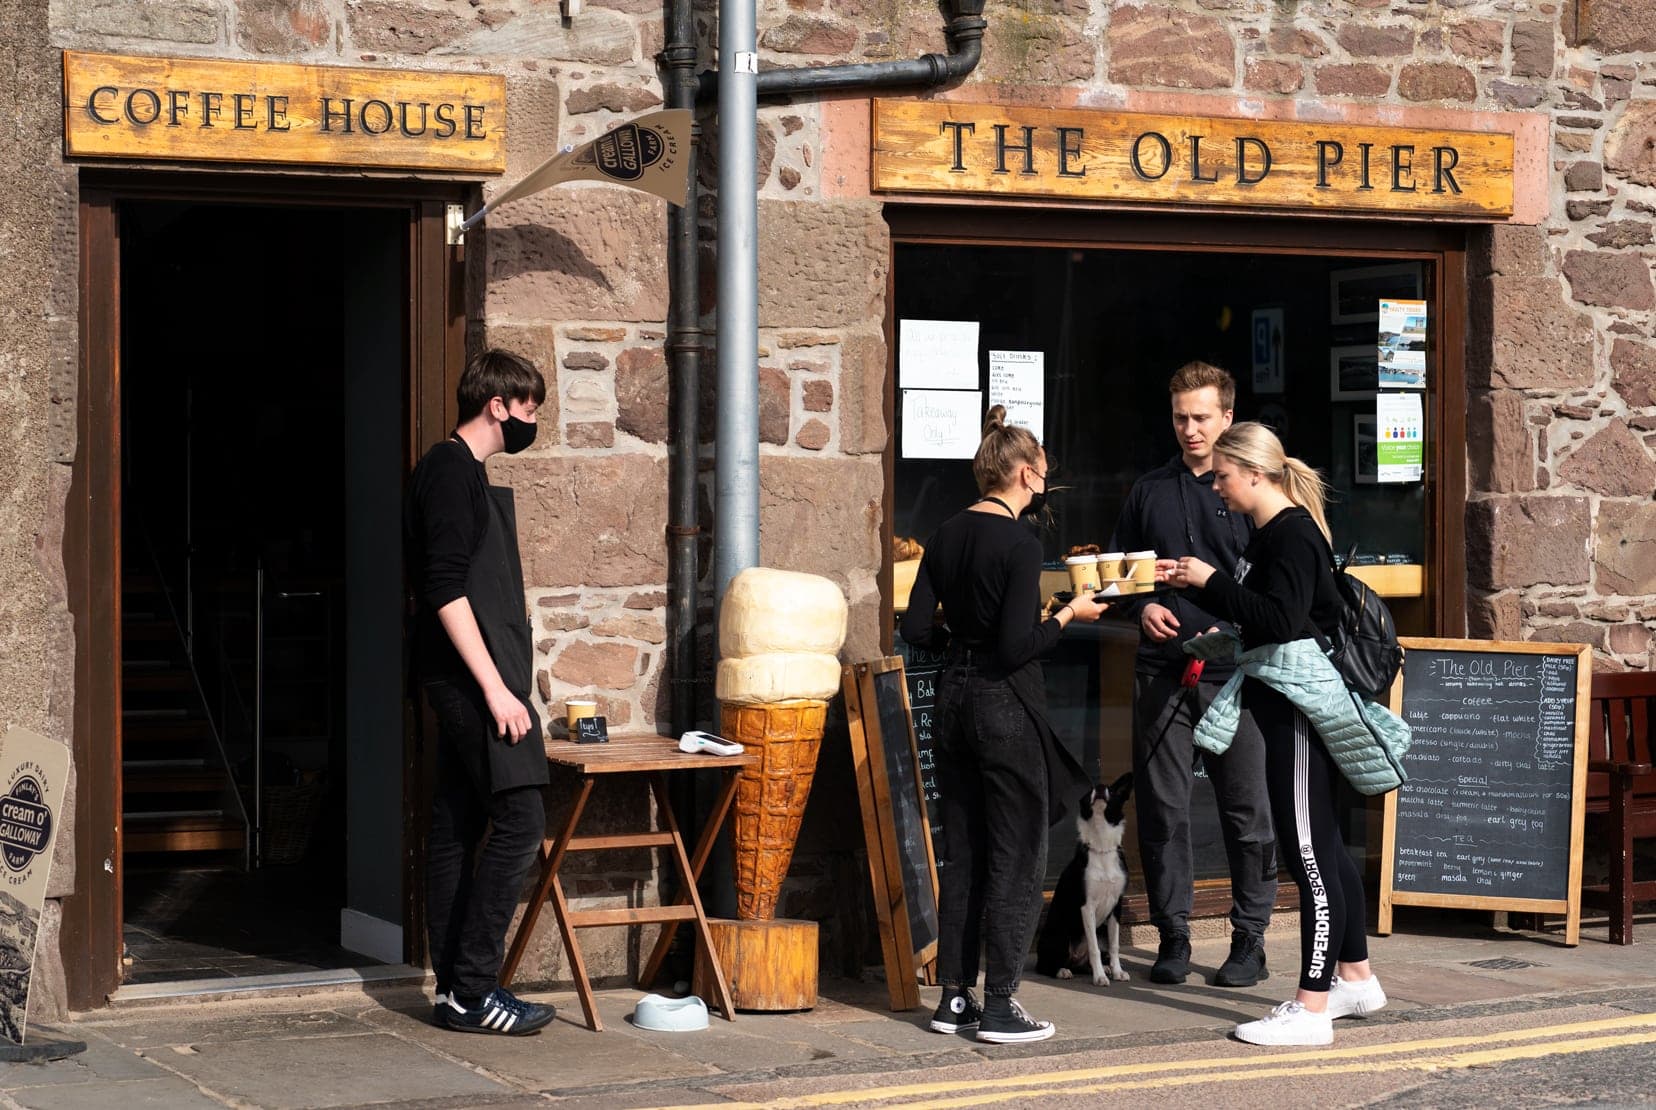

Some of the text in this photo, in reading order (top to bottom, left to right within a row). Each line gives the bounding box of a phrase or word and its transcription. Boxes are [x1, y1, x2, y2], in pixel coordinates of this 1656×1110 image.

[87, 86, 488, 141] COFFEE HOUSE
[654, 124, 677, 172] ICE CREAM
[939, 121, 1463, 194] THE OLD PIER
[1436, 658, 1528, 677] The Old Pier
[2, 803, 35, 824] cream
[0, 823, 41, 846] GALLOWAY
[8, 852, 25, 865] FARM
[8, 868, 33, 885] CREAM
[1308, 901, 1329, 979] SUPERDRY
